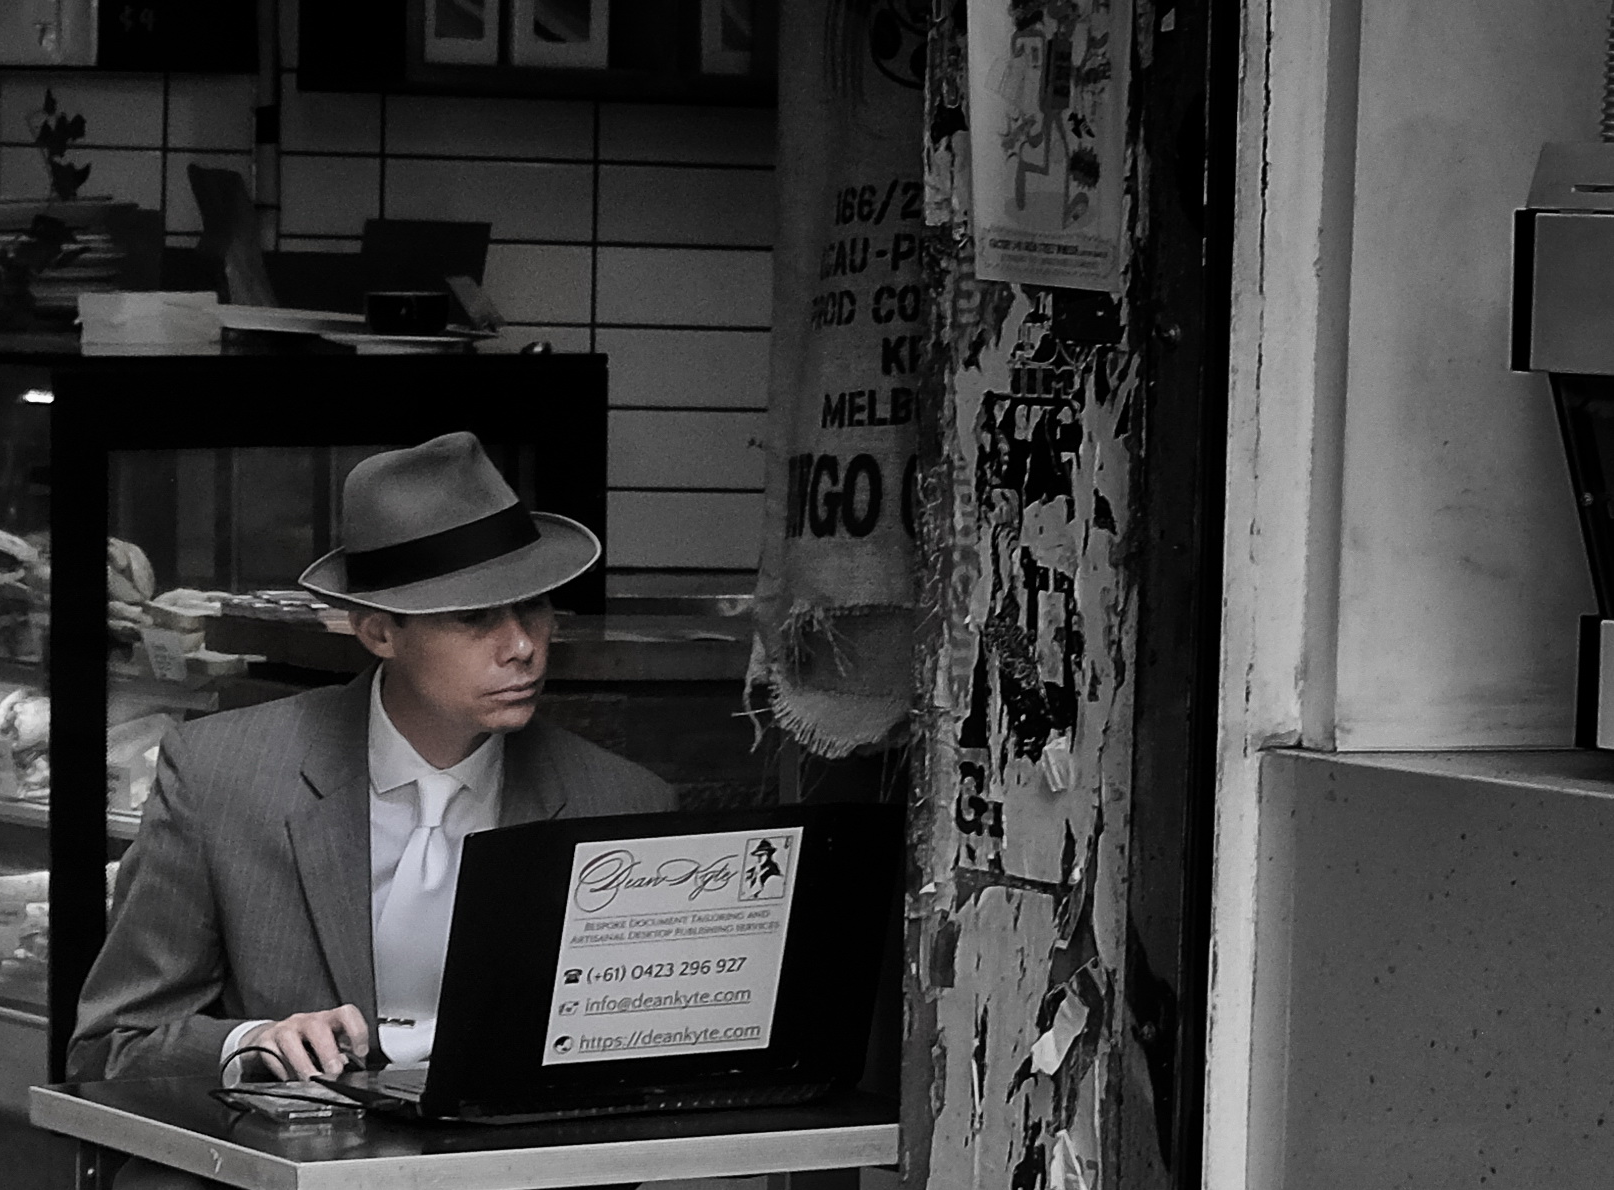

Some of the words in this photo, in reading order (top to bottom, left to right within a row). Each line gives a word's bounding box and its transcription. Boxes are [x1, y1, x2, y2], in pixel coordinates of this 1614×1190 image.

[820, 386, 922, 429] MELB
[586, 965, 627, 985] (+61)
[631, 961, 675, 981] 0423
[679, 958, 711, 977] 296
[715, 956, 748, 974] 927
[585, 988, 752, 1014] info@deankyte.com
[578, 1024, 762, 1052] https://deankyte.com
